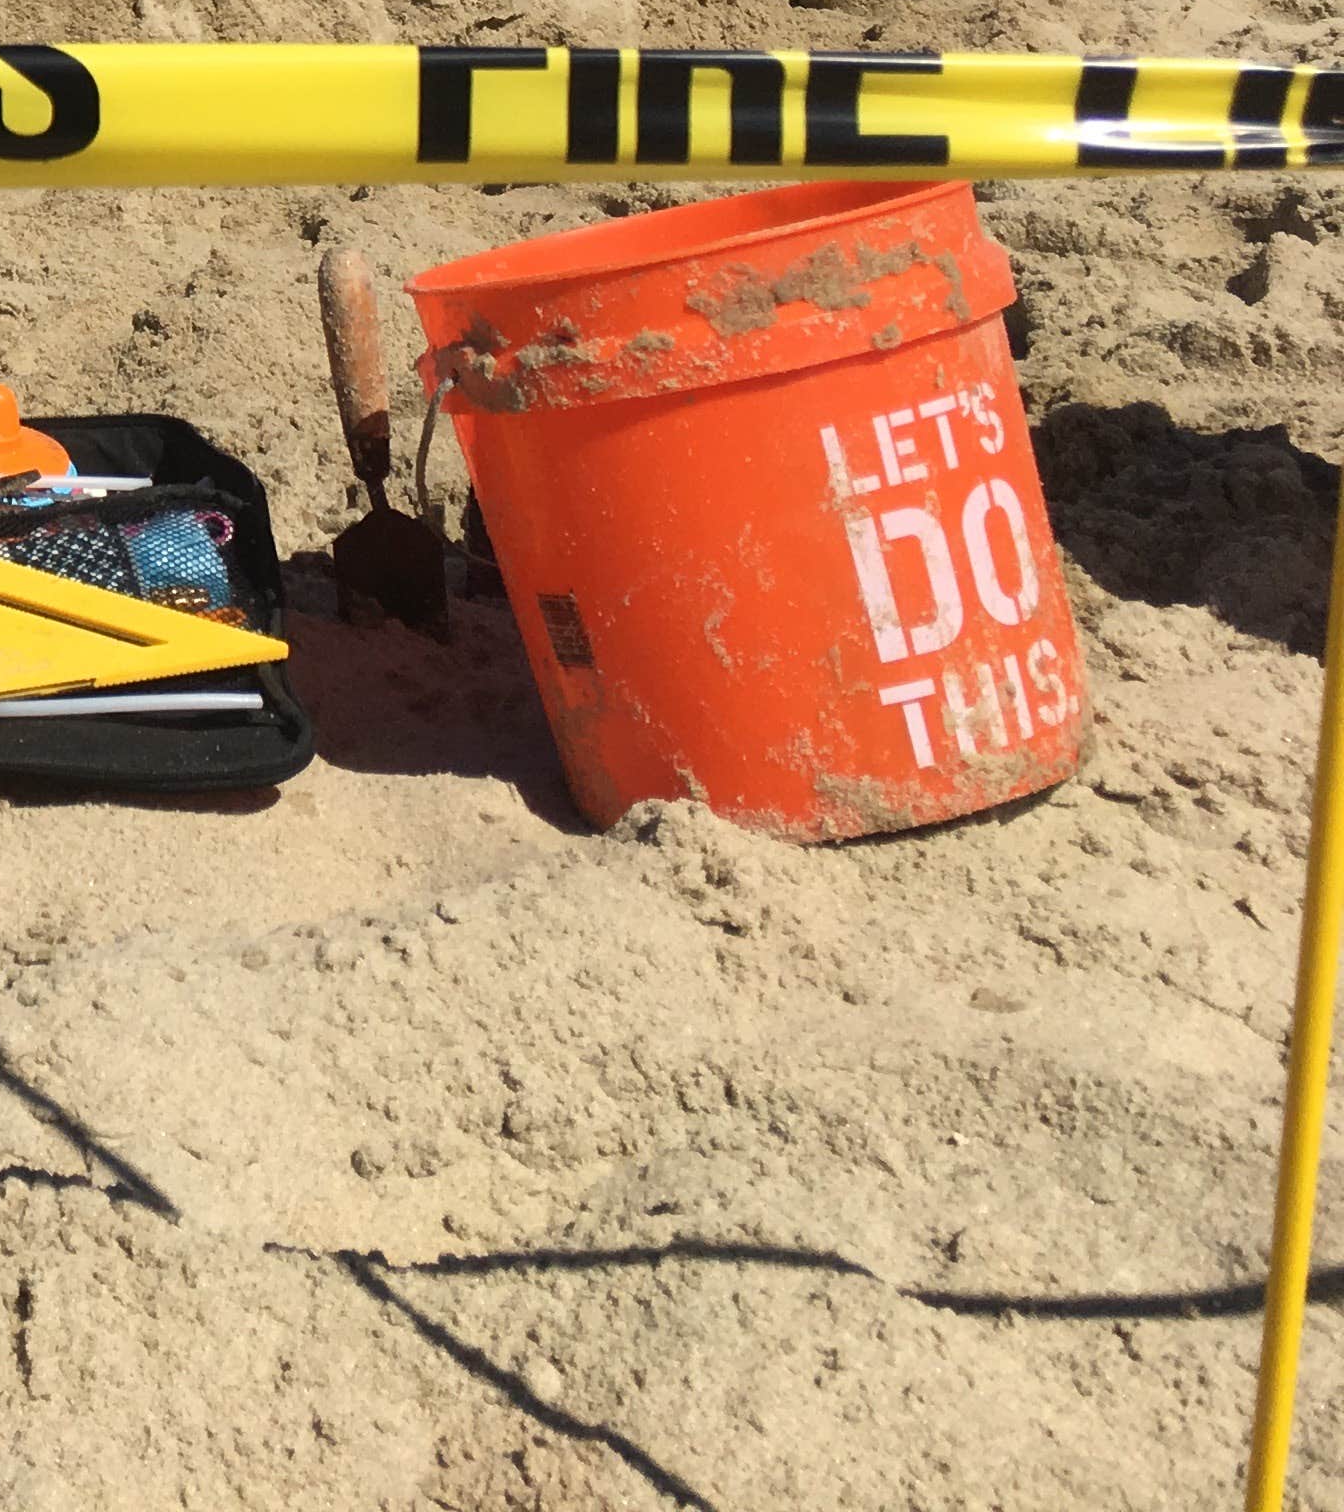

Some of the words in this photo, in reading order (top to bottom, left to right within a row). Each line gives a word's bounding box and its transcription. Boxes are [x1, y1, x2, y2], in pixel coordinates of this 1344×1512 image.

[820, 382, 1005, 502] LET'S
[844, 479, 1039, 663] DO
[879, 638, 1079, 768] THIS.
